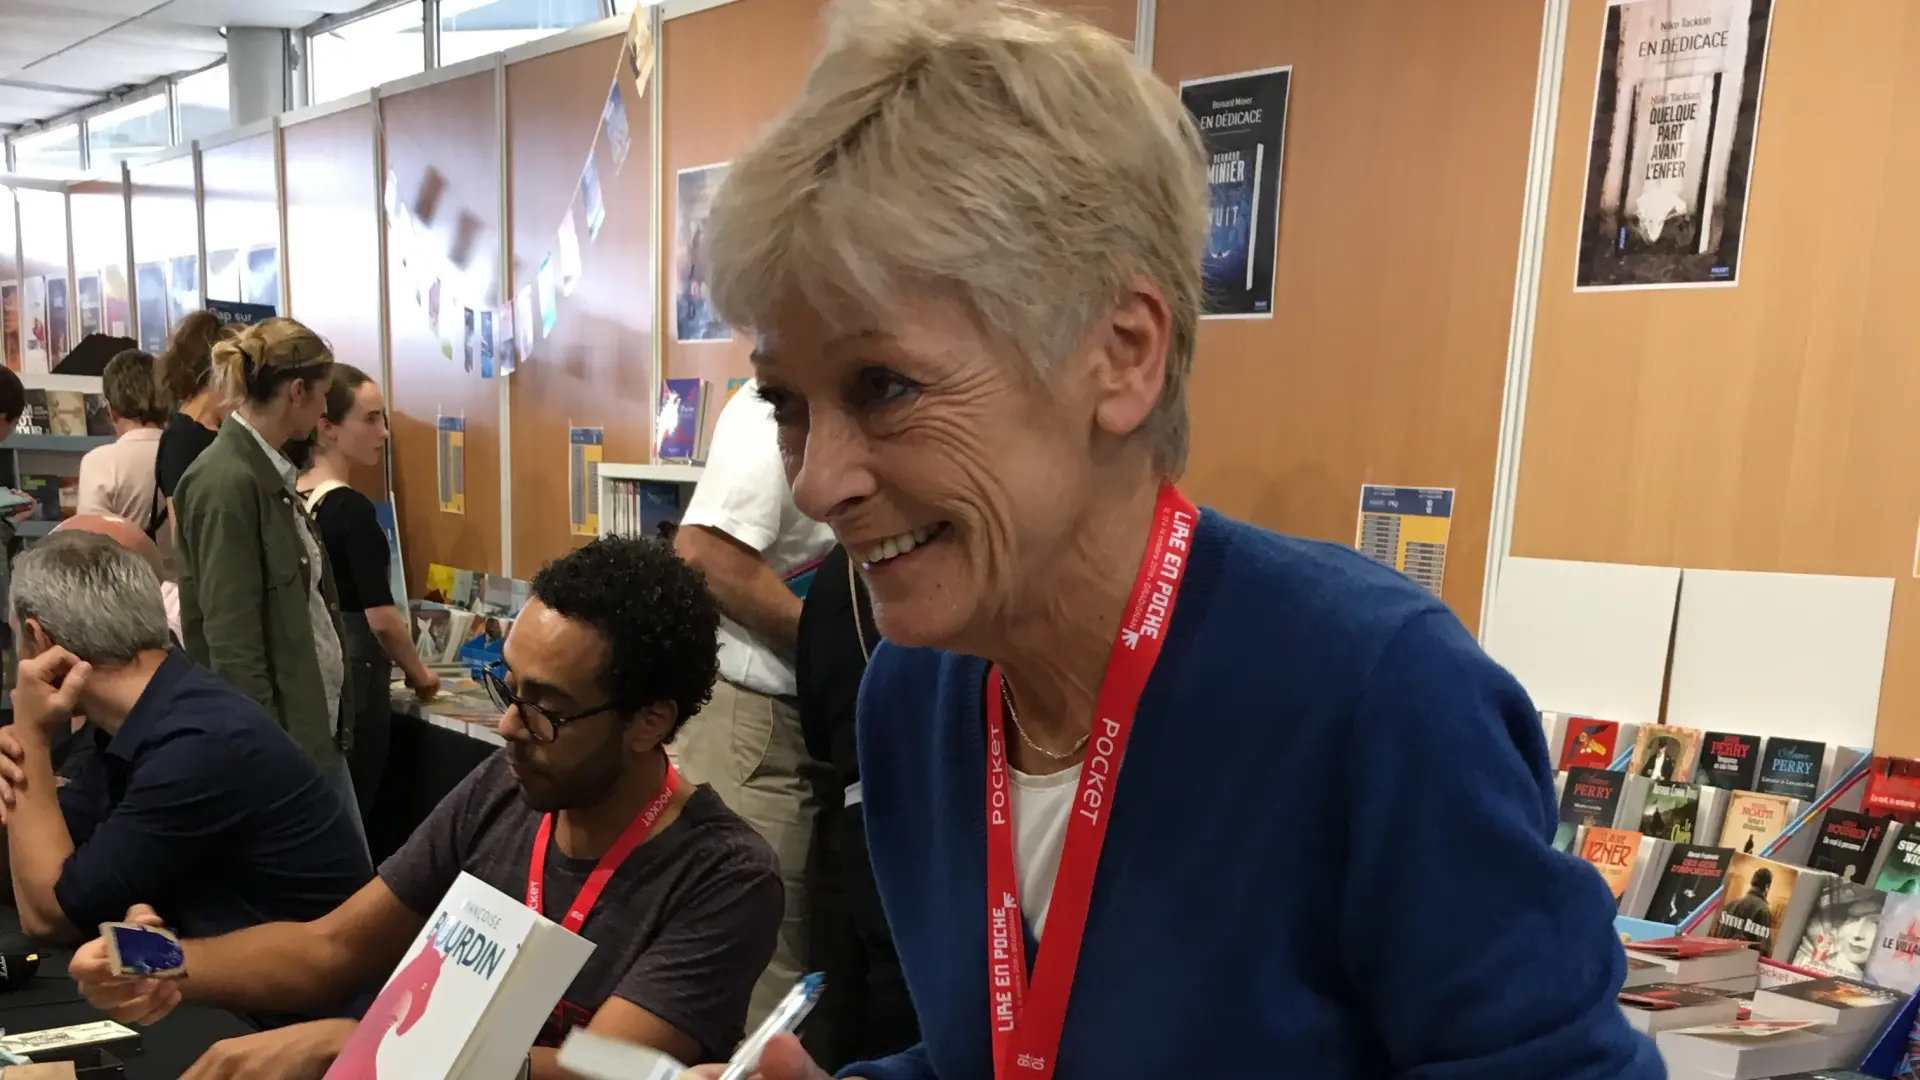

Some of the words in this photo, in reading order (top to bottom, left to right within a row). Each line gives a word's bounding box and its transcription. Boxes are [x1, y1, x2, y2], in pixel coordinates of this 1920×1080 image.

[1639, 40, 1657, 57] EN
[1661, 30, 1729, 55] DÉDICACE
[1200, 115, 1214, 130] EN
[1215, 108, 1263, 128] DÉDICACE
[1649, 103, 1697, 125] QUELQUE
[1656, 123, 1685, 142] PART
[1651, 142, 1684, 161] AVANT
[1206, 160, 1245, 184] MINIER
[1645, 160, 1686, 180] L'ENFER
[1209, 205, 1239, 227] UIT
[1139, 580, 1174, 640] POCHE
[1710, 741, 1751, 759] PERRY
[1771, 758, 1814, 775] PERRY
[1572, 783, 1613, 799] PERRY
[1586, 841, 1632, 867] IZNER
[461, 898, 502, 930] RANÇOISE
[1719, 910, 1745, 930] STEVE
[1744, 917, 1770, 939] BERRY
[992, 907, 1009, 960] POCHE
[1882, 936, 1894, 949] LE
[1756, 964, 1788, 982] ocket
